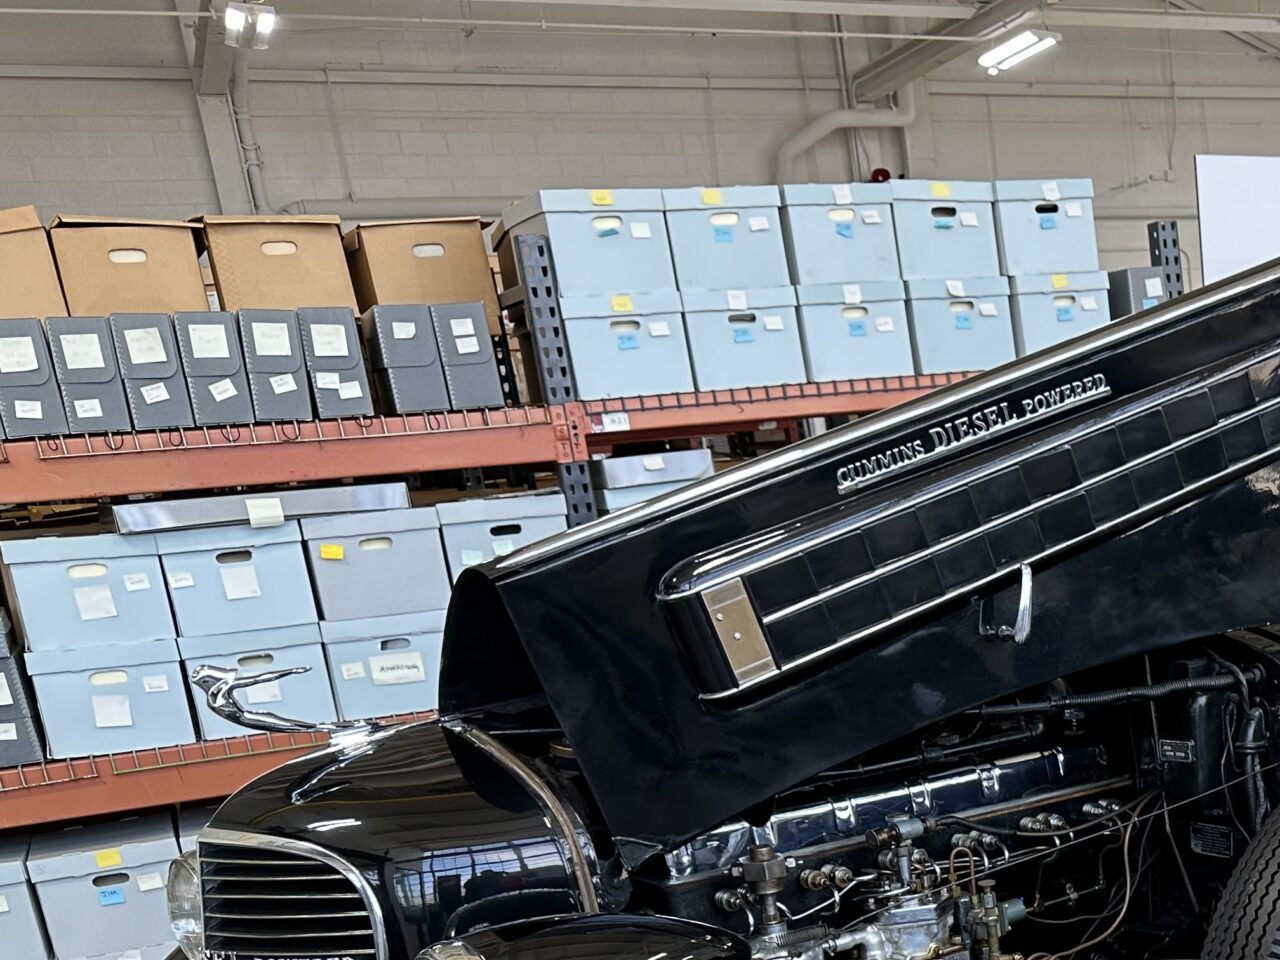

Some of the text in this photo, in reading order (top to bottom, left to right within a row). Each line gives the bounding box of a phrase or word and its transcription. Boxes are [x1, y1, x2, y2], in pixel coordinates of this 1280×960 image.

[836, 373, 1109, 486] CUMMINS DIESEL POWERED
[99, 889, 119, 898] JIM
